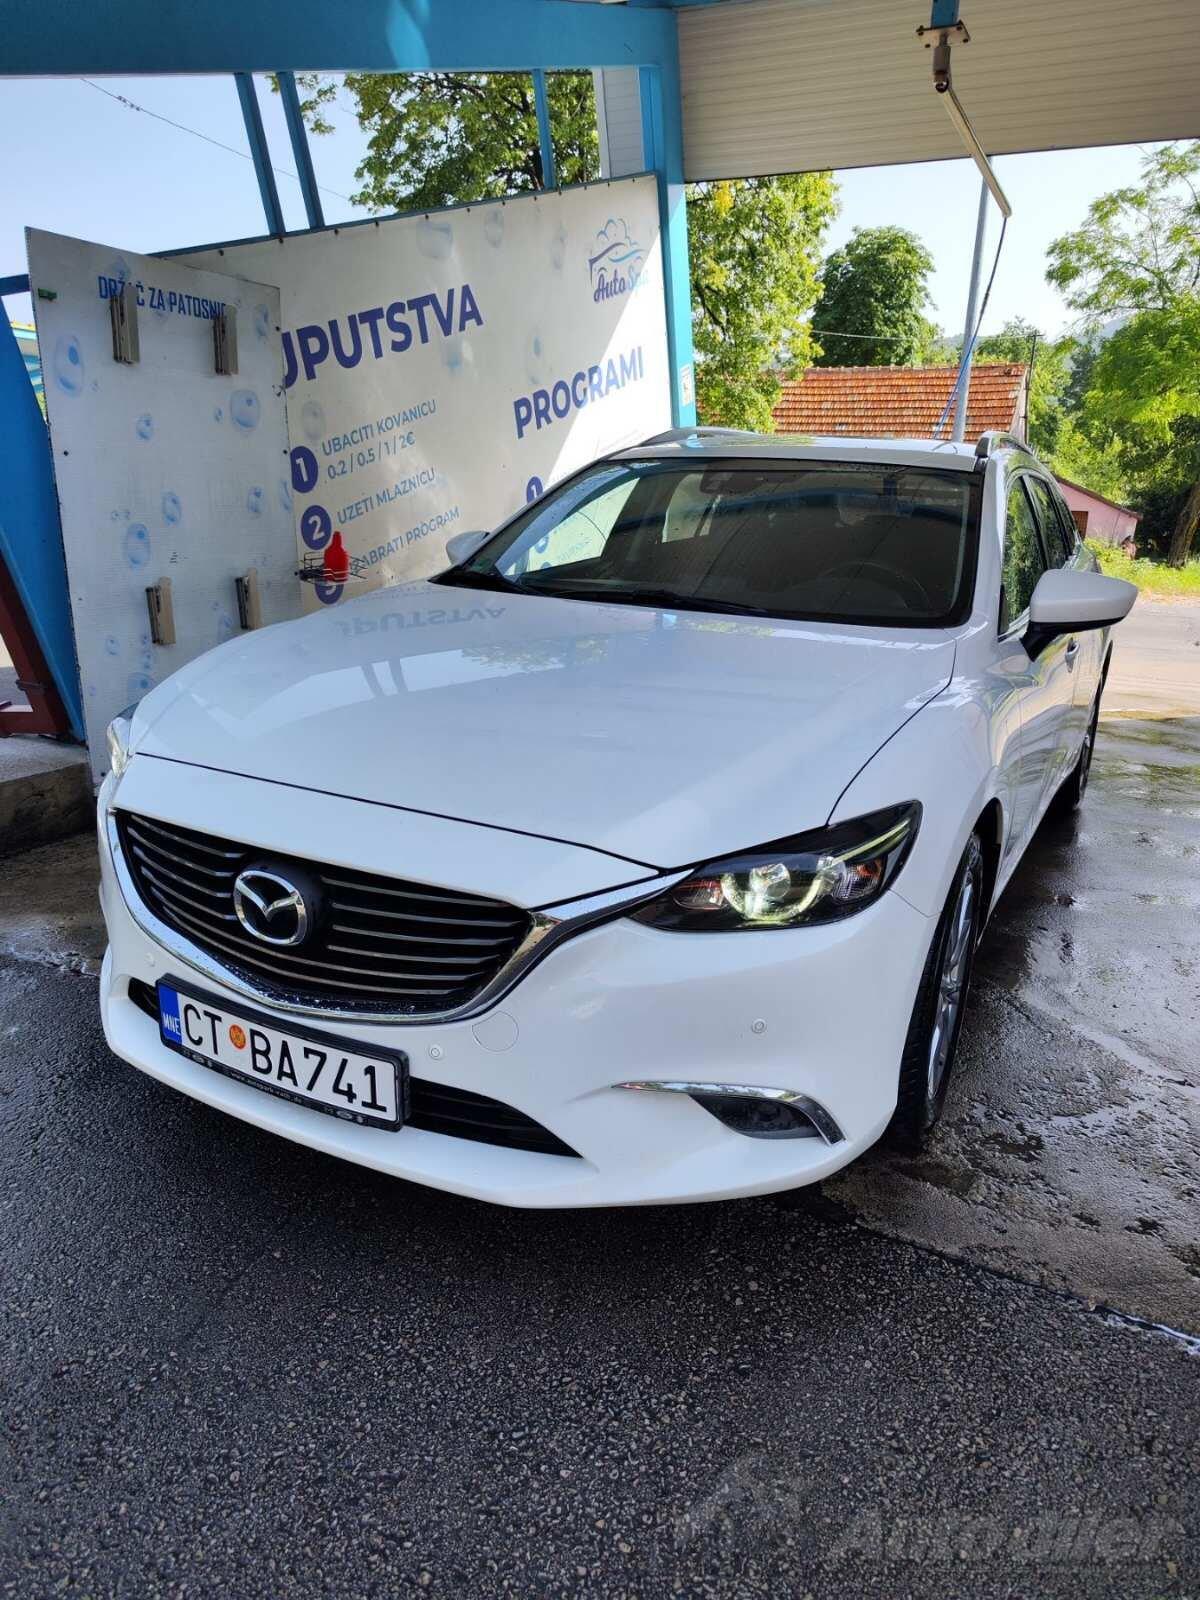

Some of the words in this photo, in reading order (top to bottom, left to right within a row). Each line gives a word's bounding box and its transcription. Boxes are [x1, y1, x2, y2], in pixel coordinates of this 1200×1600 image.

[98, 273, 145, 306] DRŽČ
[148, 287, 166, 311] ZA
[594, 269, 626, 302] Auto
[513, 346, 644, 439] PROGRAMI
[321, 424, 375, 456] UBACITI
[376, 399, 437, 434] KOVANICU
[295, 457, 309, 482] 1
[327, 459, 348, 480] 0.2
[357, 448, 376, 467] 0.5
[337, 497, 374, 524] UZETI
[376, 468, 436, 506] MLAZNICU
[308, 515, 325, 541] 2
[406, 506, 460, 544] PROGRAM
[162, 1012, 181, 1036] MNE
[184, 1003, 222, 1055] CT
[249, 1028, 387, 1112] BA741
